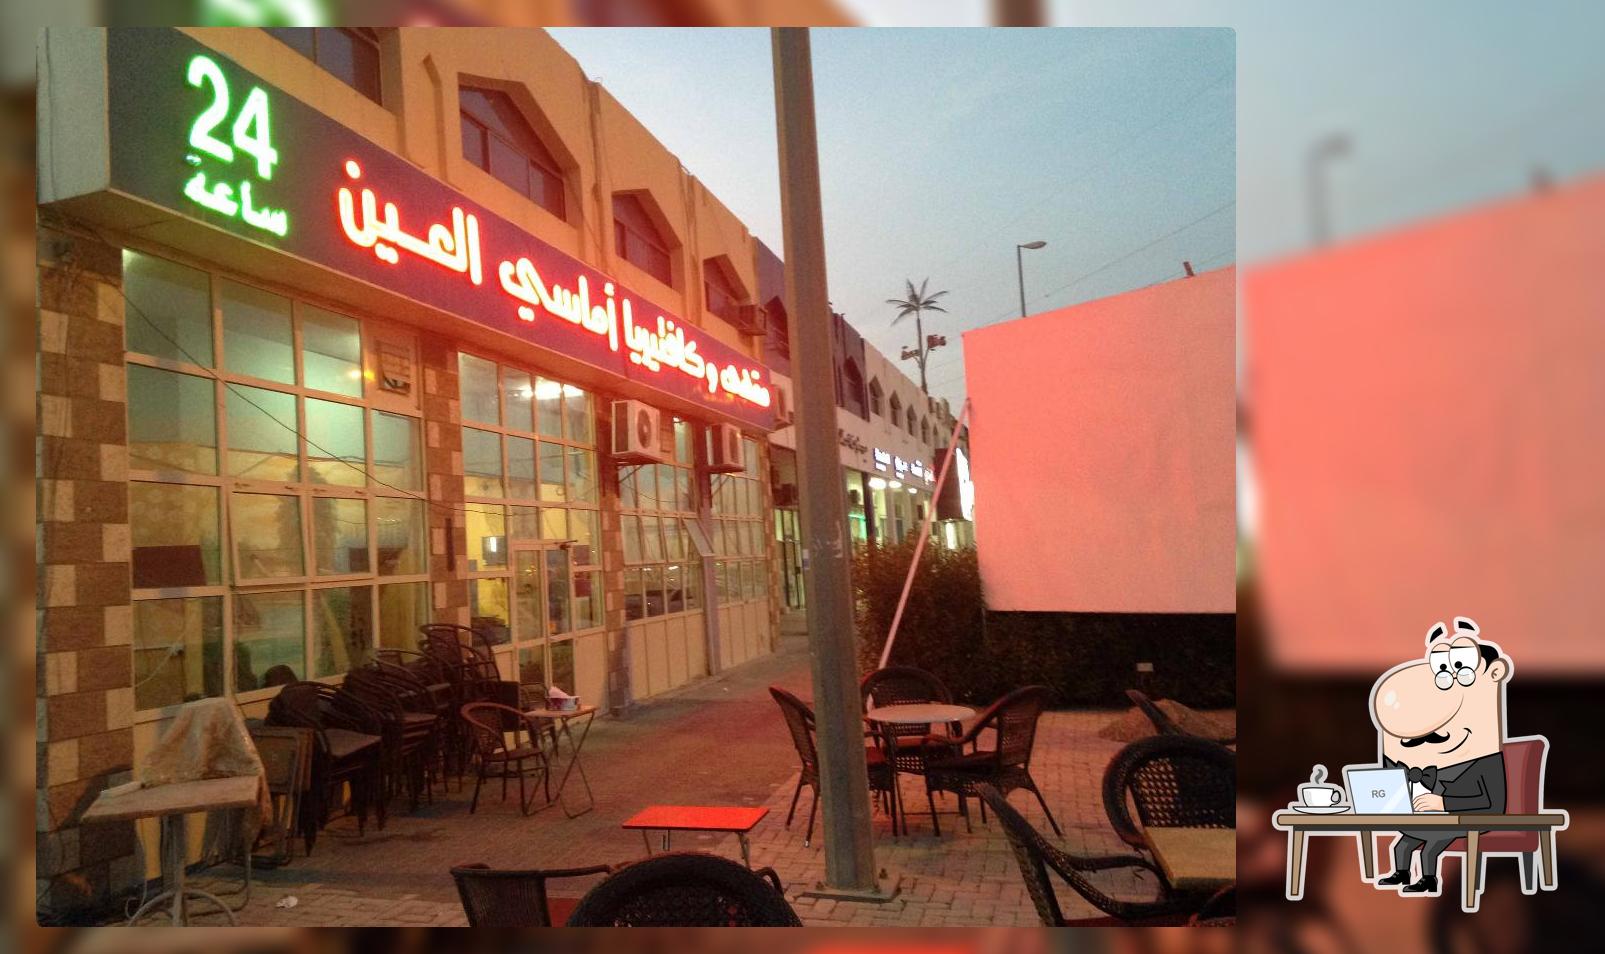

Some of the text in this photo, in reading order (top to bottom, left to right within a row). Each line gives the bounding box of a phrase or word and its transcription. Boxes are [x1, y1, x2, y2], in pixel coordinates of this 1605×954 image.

[186, 55, 279, 180] 24
[183, 155, 289, 237] ساعة
[337, 160, 483, 286] العين
[498, 258, 619, 352] أماسي
[622, 298, 706, 373] كافتيريا
[705, 362, 719, 394] و
